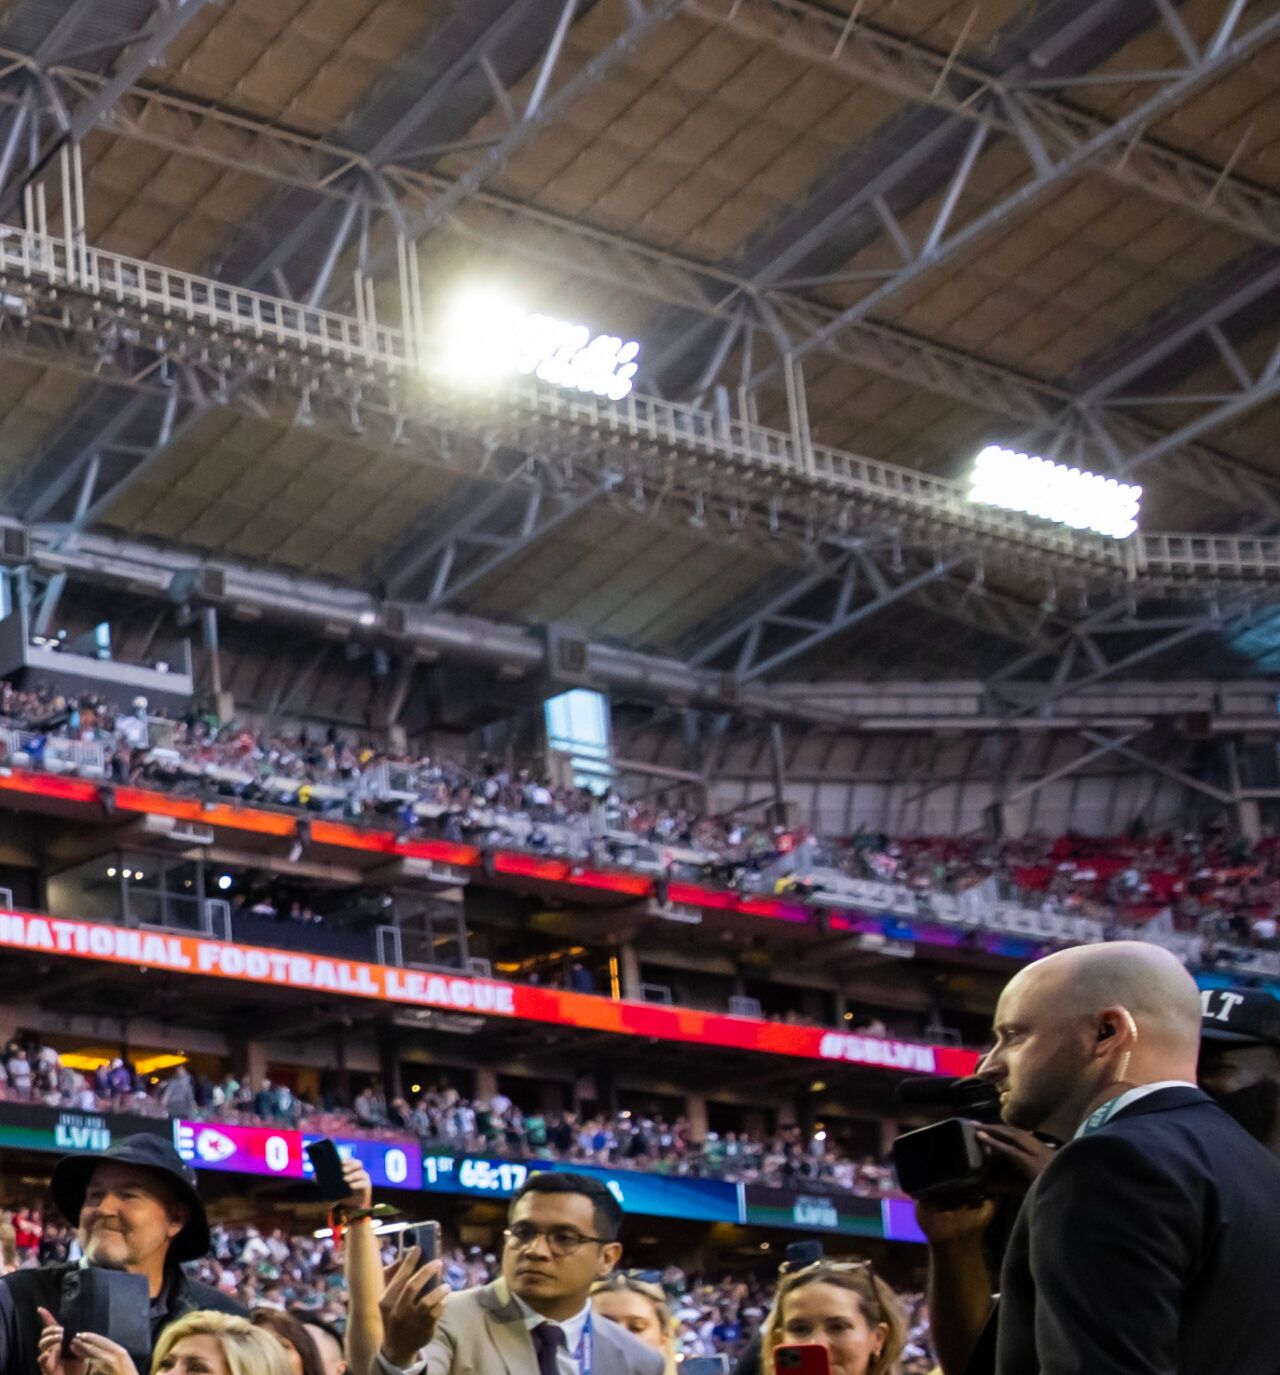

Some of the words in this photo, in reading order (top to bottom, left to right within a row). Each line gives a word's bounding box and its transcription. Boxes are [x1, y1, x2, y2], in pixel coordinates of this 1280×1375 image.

[198, 943, 379, 994] FOOTBALL
[385, 969, 515, 1013] LEAGUE
[55, 1125, 110, 1150] LVII
[265, 1136, 289, 1171] 0
[384, 1149, 407, 1183] 0
[459, 1159, 527, 1190] 65:17
